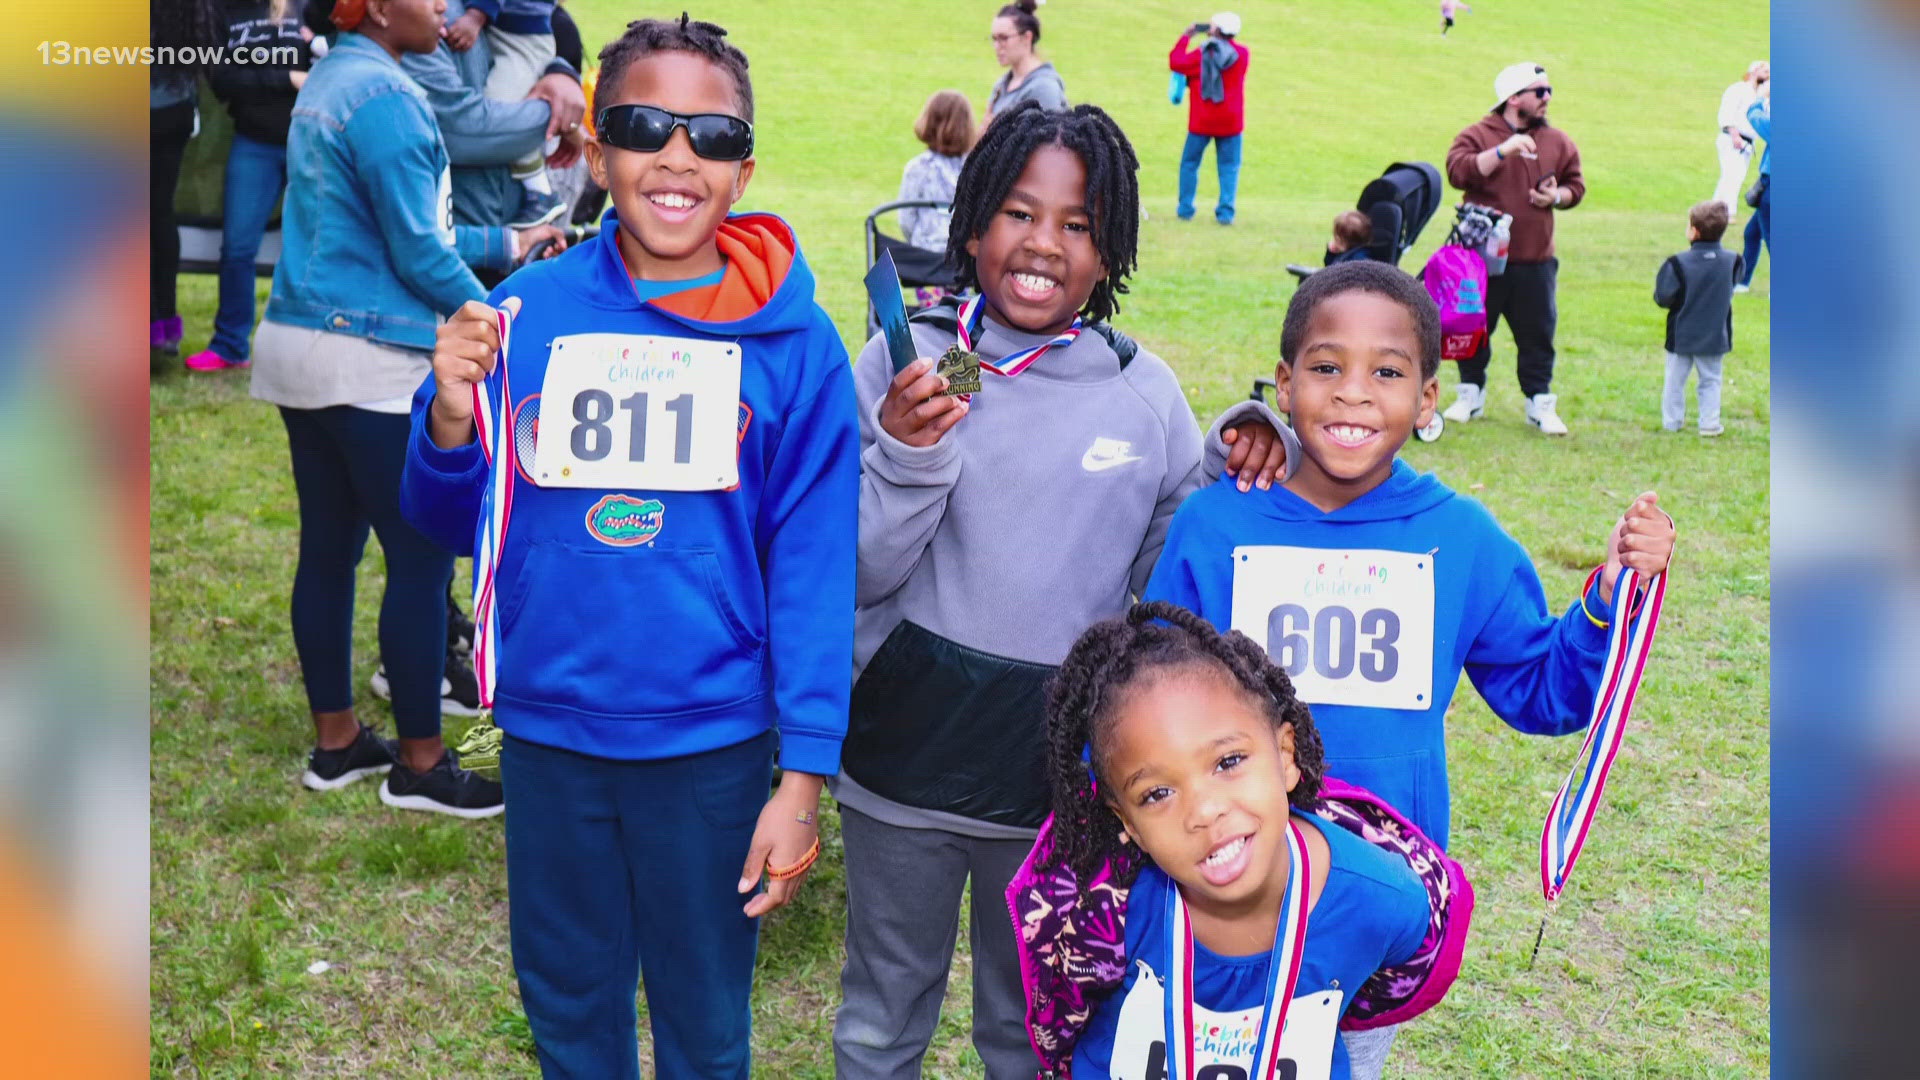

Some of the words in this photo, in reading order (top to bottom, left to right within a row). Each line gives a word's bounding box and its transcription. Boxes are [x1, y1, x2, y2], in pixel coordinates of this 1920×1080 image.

[607, 362, 676, 383] Children
[570, 388, 694, 465] 811
[1266, 603, 1401, 683] 603
